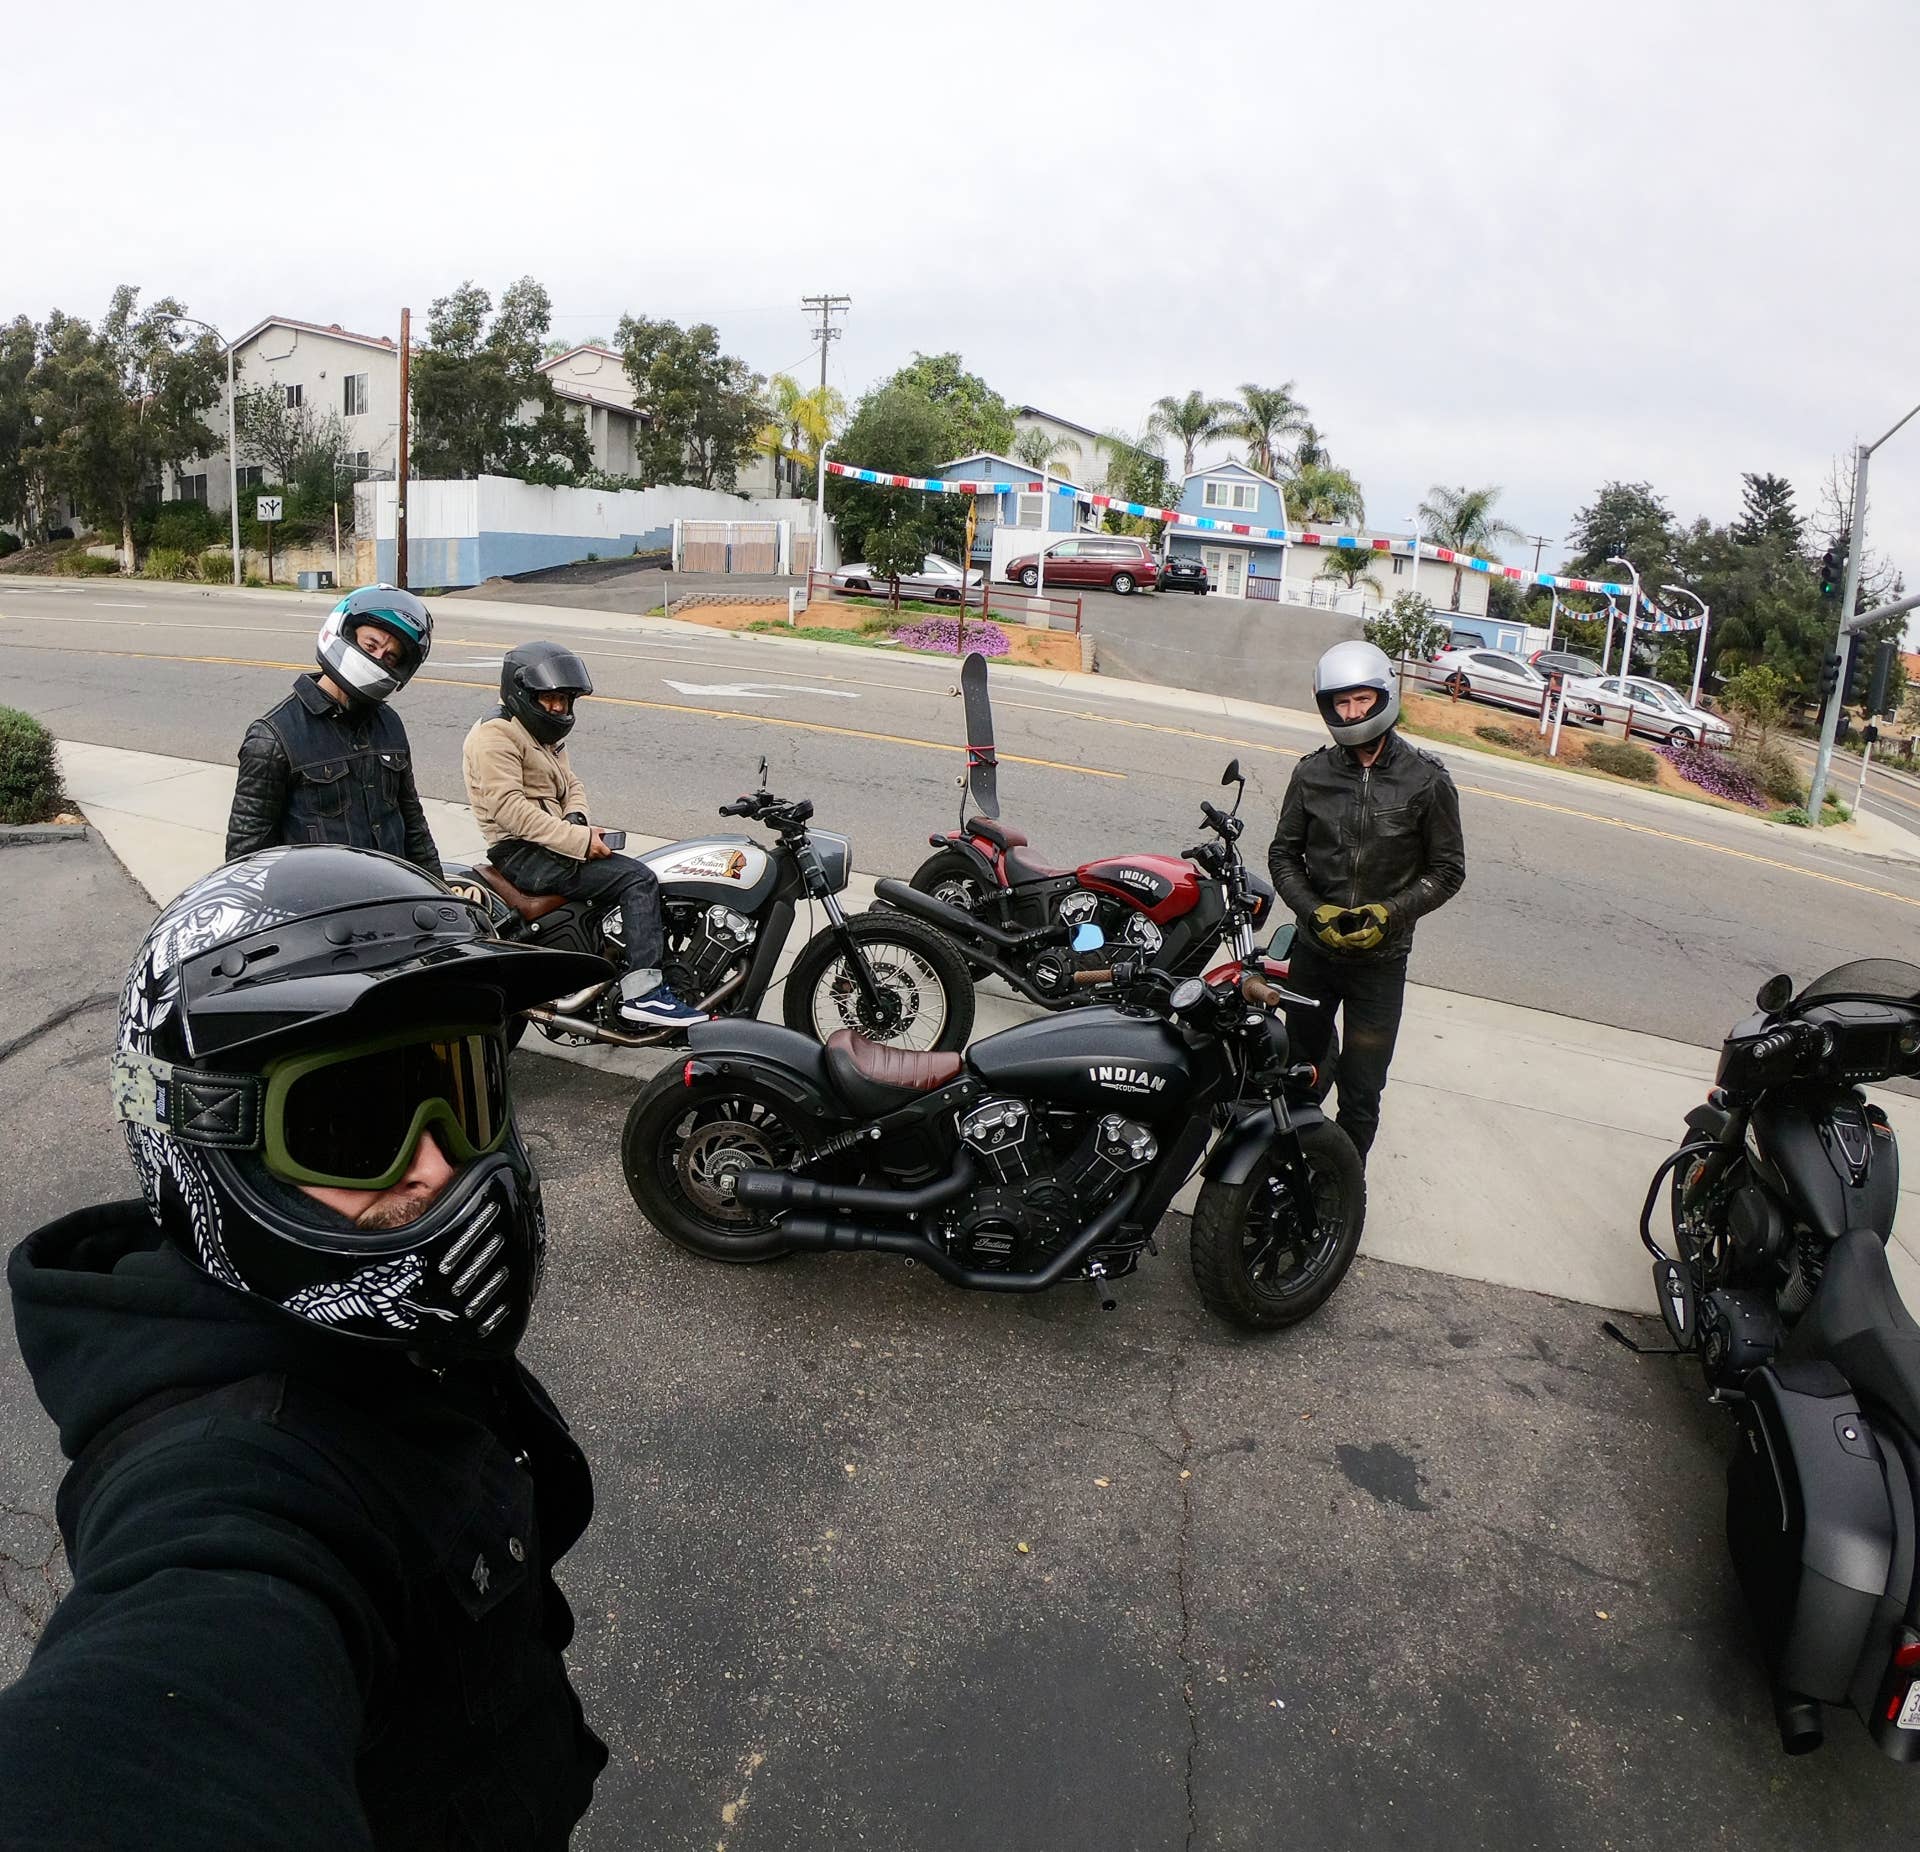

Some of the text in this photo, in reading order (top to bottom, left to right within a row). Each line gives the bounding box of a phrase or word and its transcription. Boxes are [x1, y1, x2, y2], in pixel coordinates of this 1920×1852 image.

[690, 856, 724, 869] Indian
[1119, 870, 1160, 891] INDIAN
[1088, 1066, 1167, 1092] INDIAN
[1114, 1083, 1137, 1093] SCOUT
[974, 1238, 1011, 1250] Indian
